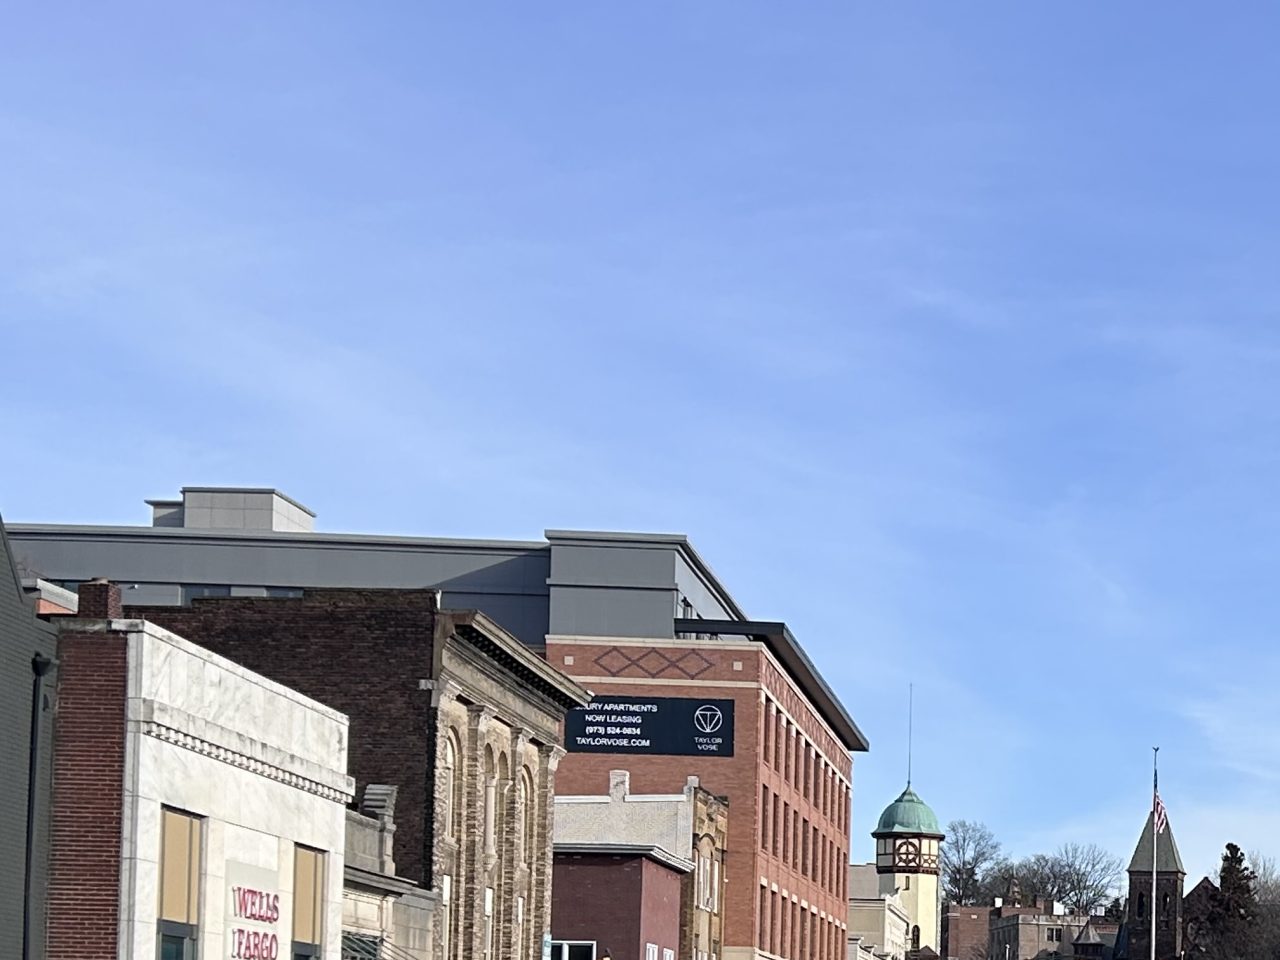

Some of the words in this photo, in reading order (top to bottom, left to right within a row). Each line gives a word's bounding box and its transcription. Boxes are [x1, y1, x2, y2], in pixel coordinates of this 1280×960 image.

[603, 704, 658, 713] APARTMENTS
[607, 716, 642, 724] LEASING
[576, 737, 650, 747] TAYLORVOSE.COM
[232, 886, 279, 923] WELLS
